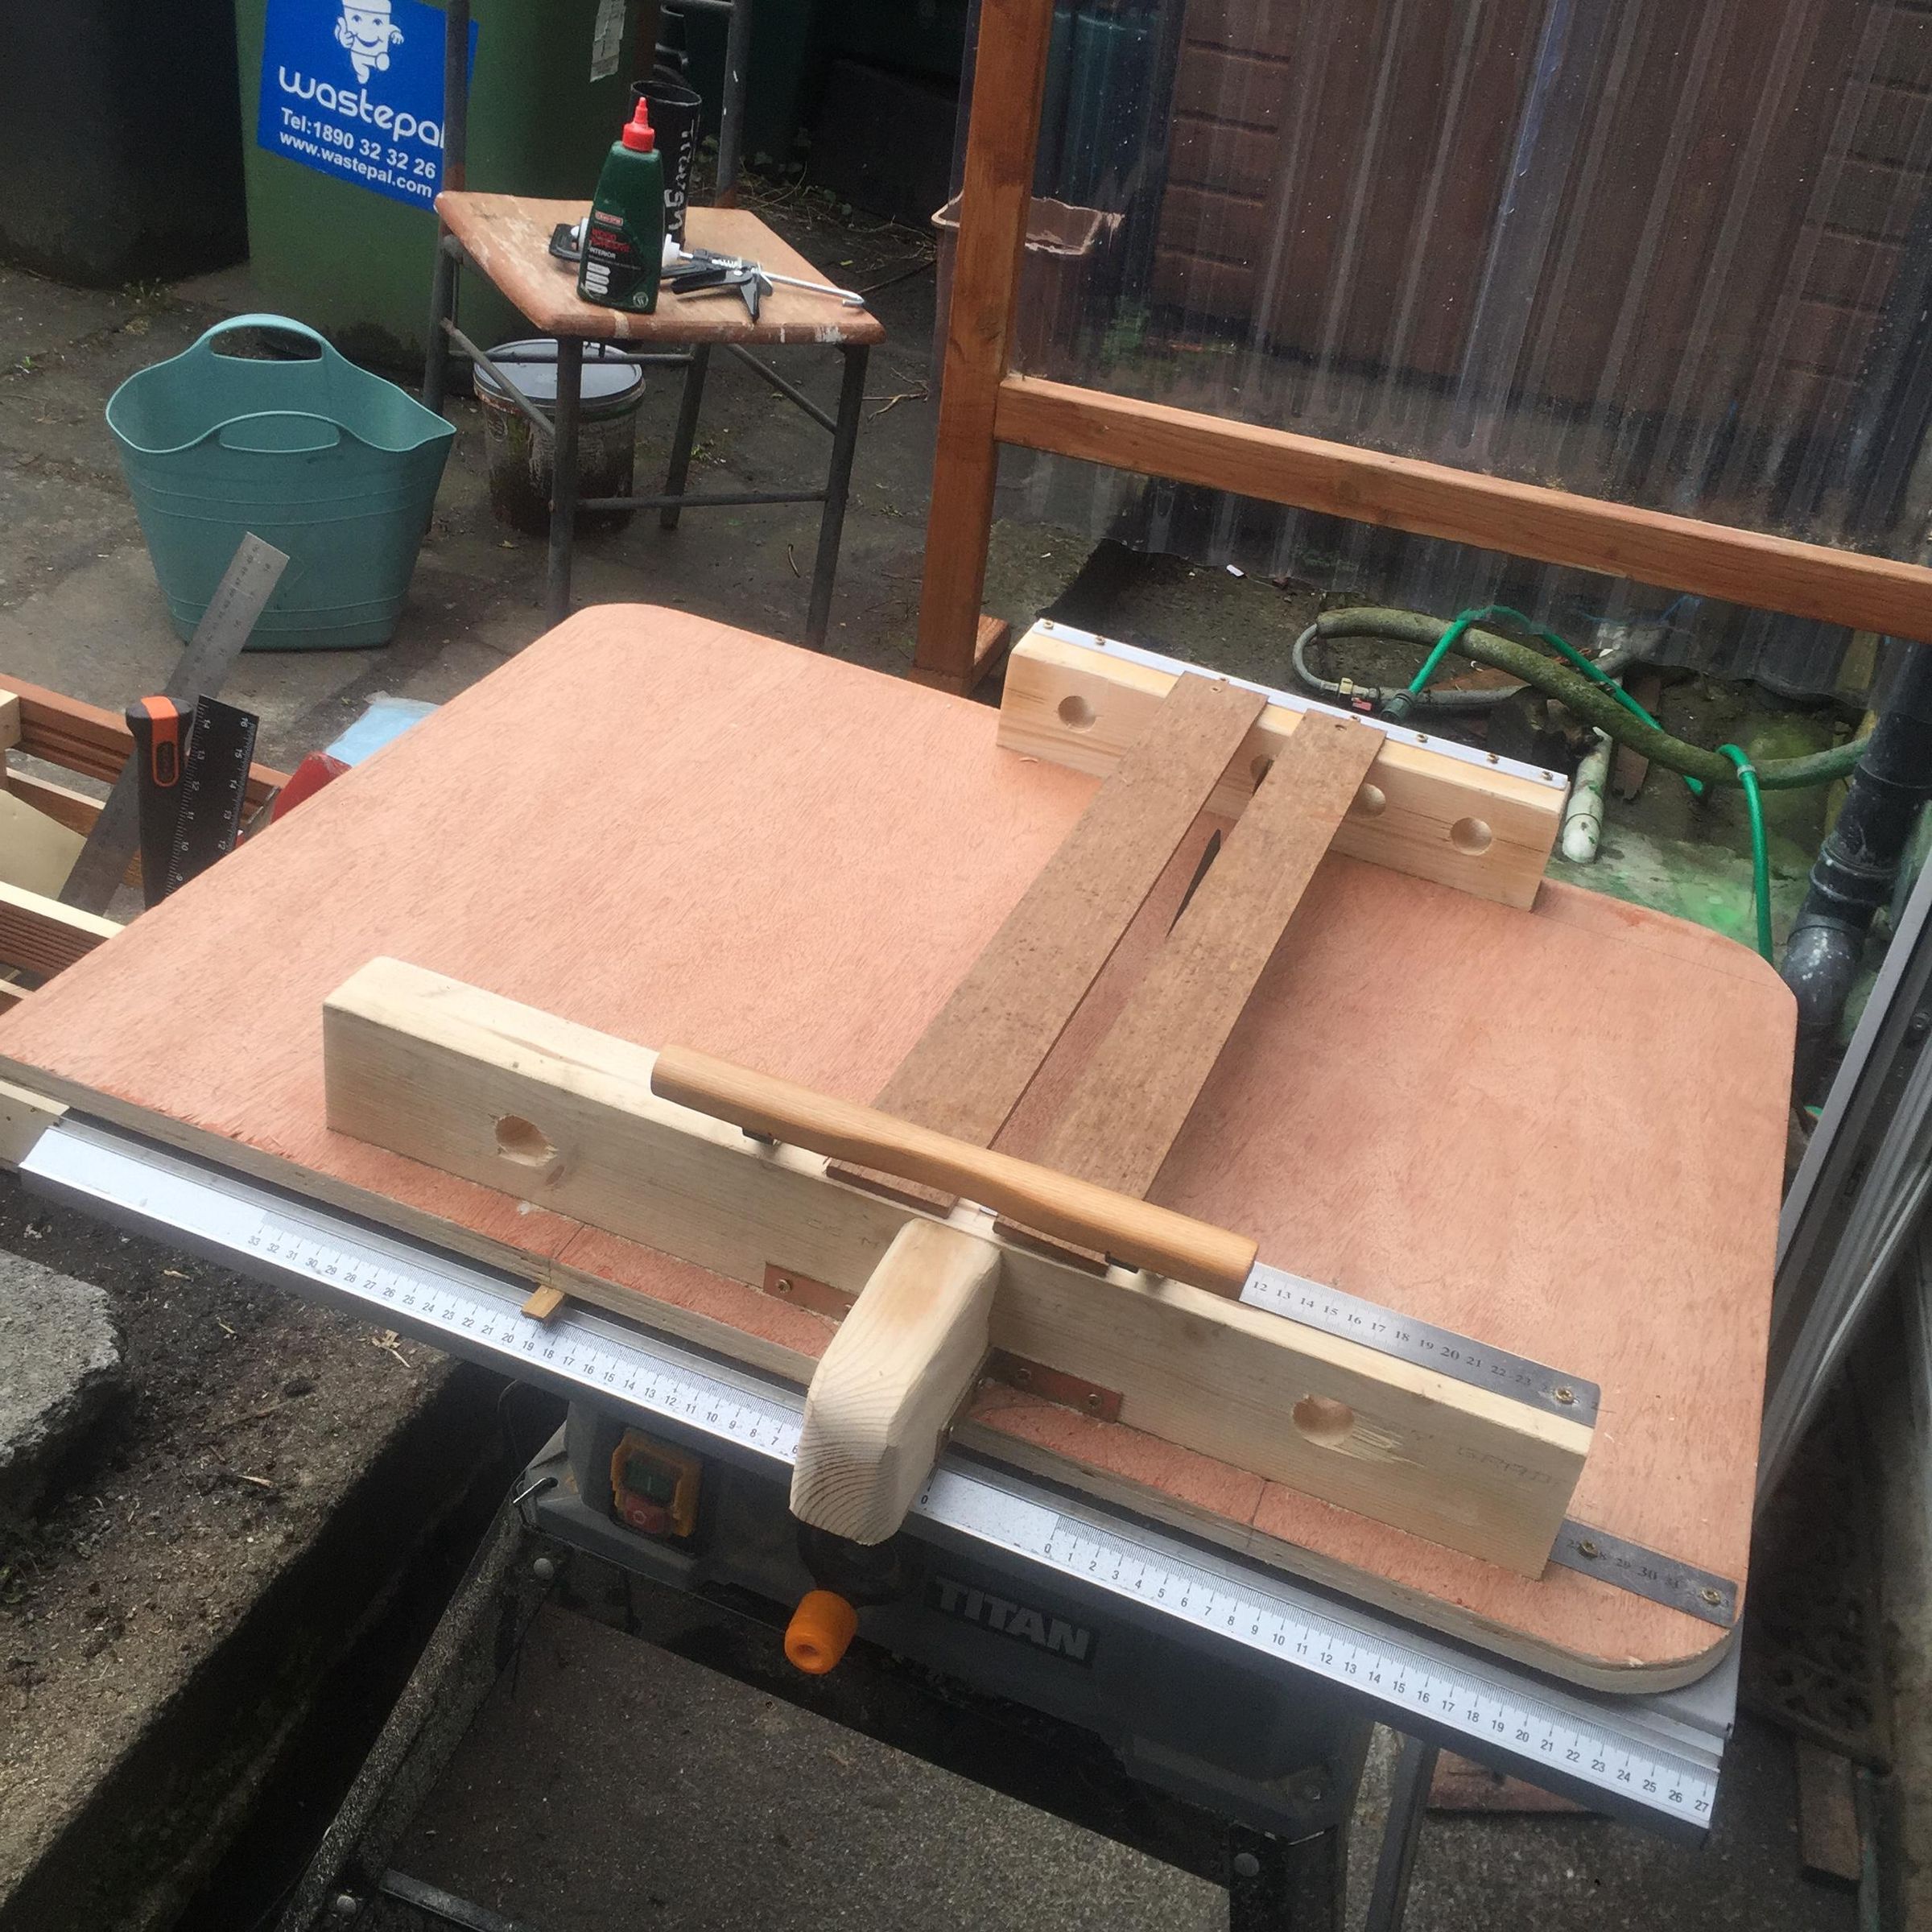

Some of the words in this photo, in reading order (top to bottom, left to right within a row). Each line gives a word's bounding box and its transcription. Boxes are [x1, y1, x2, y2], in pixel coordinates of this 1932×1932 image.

[281, 106, 354, 151] Tel:1890
[359, 138, 382, 160] 32
[386, 148, 408, 170] 32
[413, 158, 436, 179] 26
[279, 130, 432, 198] www.wastepal.com
[589, 246, 617, 259] INTERIOR
[241, 717, 249, 728] 16
[234, 749, 242, 758] 15
[229, 779, 237, 789] 14
[186, 811, 195, 820] 11
[181, 841, 189, 851] 10
[217, 840, 226, 850] 12
[175, 873, 184, 881] 9
[1253, 1281, 1268, 1292] 12
[1276, 1289, 1291, 1300] 13
[1299, 1297, 1315, 1309] 14
[1323, 1305, 1339, 1316] 15
[1347, 1314, 1362, 1325] 16
[1371, 1323, 1387, 1332] 17
[1395, 1331, 1410, 1342] 18
[1419, 1339, 1435, 1351] 19
[1440, 1346, 1460, 1361] 20
[1466, 1356, 1482, 1368] 21
[1491, 1364, 1507, 1377] 22
[1515, 1374, 1532, 1386] 23
[247, 1235, 262, 1247] 33
[266, 1242, 280, 1254] 32
[285, 1250, 299, 1261] 31
[305, 1257, 319, 1269] 30
[324, 1265, 338, 1276] 29
[343, 1272, 357, 1283] 28
[362, 1279, 377, 1290] 27
[382, 1286, 396, 1298] 26
[402, 1294, 416, 1306] 25
[422, 1302, 436, 1313] 24
[441, 1309, 456, 1320] 23
[460, 1317, 475, 1328] 22
[481, 1324, 494, 1335] 21
[501, 1332, 514, 1344] 20
[522, 1340, 535, 1352] 19
[543, 1348, 555, 1360] 18
[563, 1356, 576, 1366] 17
[583, 1364, 595, 1375] 16
[603, 1371, 616, 1383] 15
[623, 1379, 636, 1391] 14
[644, 1387, 657, 1398] 13
[664, 1395, 677, 1406] 12
[685, 1403, 697, 1414] 11
[706, 1411, 719, 1423] 10
[728, 1419, 737, 1430] 9
[749, 1428, 758, 1438] 8
[770, 1435, 779, 1446] 7
[920, 1493, 929, 1505] 0
[935, 1575, 1090, 1661] TITAN
[1043, 1542, 1052, 1554] 0
[1067, 1552, 1074, 1563] 1
[1088, 1560, 1097, 1572] 2
[1111, 1570, 1120, 1580] 3
[1134, 1579, 1142, 1590] 4
[1157, 1587, 1166, 1600] 5
[1180, 1596, 1189, 1608] 6
[1204, 1605, 1212, 1616] 7
[1227, 1615, 1236, 1626] 8
[1250, 1624, 1259, 1635] 9
[1273, 1633, 1286, 1646] 10
[1297, 1642, 1308, 1655] 11
[1320, 1652, 1333, 1666] 12
[1344, 1662, 1357, 1674] 13
[1368, 1671, 1381, 1684] 14
[1393, 1680, 1406, 1694] 15
[1418, 1690, 1430, 1703] 16
[1442, 1699, 1455, 1712] 17
[1467, 1710, 1480, 1723] 18
[1492, 1719, 1505, 1733] 19
[1515, 1728, 1530, 1743] 20
[1540, 1739, 1554, 1752] 21
[1566, 1748, 1581, 1763] 22
[1591, 1759, 1606, 1773] 23
[1616, 1769, 1631, 1783] 24
[1642, 1778, 1657, 1794] 25
[1668, 1789, 1682, 1803] 26
[1694, 1799, 1710, 1813] 27
